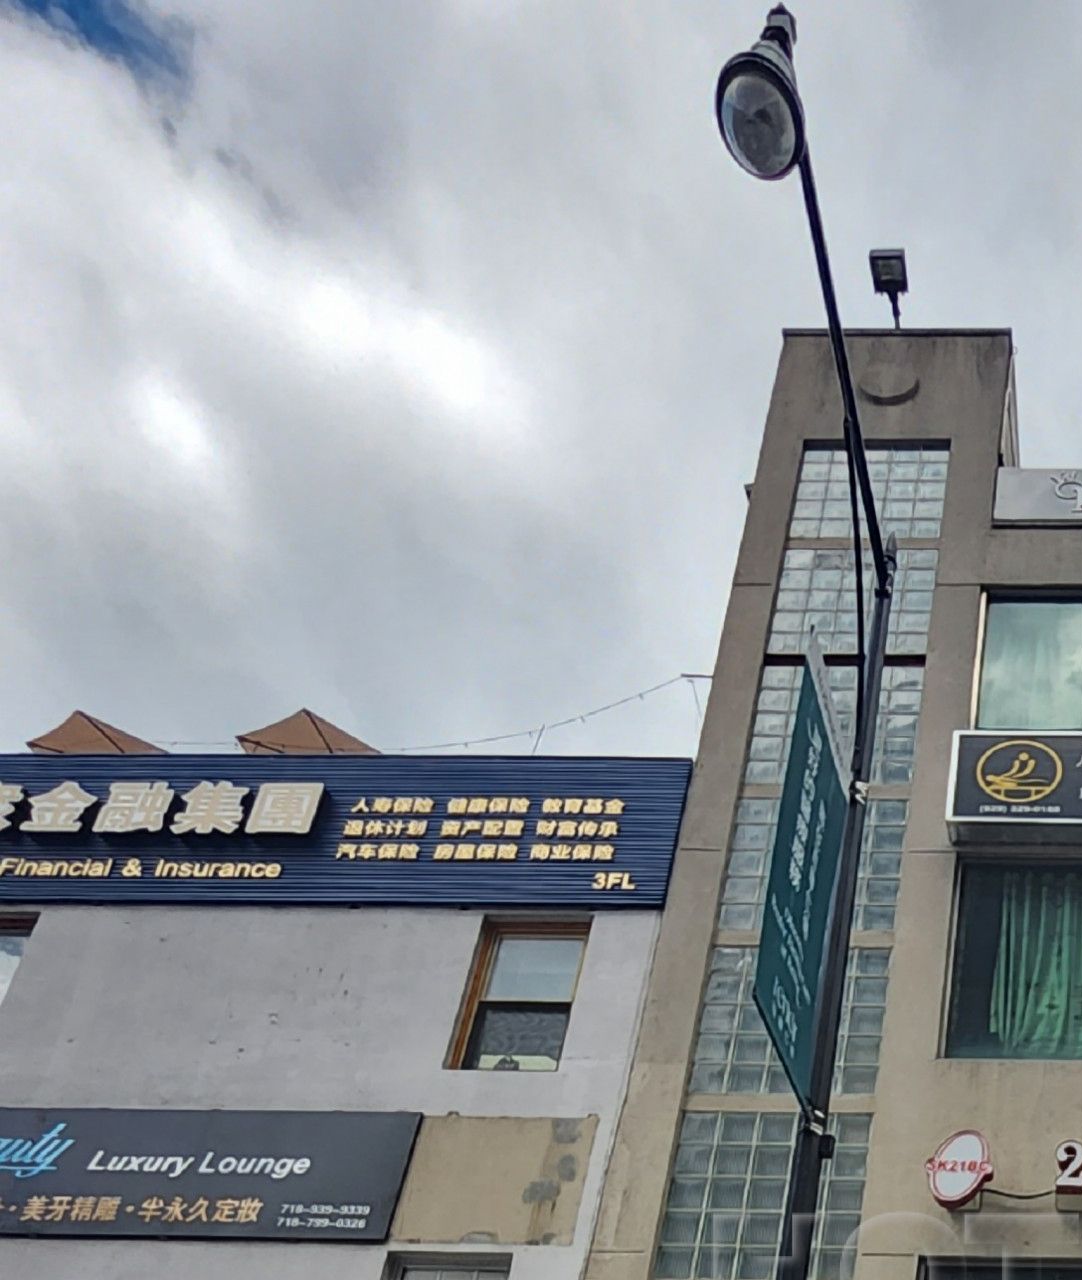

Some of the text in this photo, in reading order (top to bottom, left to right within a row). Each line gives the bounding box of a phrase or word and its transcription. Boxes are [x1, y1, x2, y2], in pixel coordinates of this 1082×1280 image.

[0, 858, 282, 878] Financial & Insurance
[592, 872, 635, 890] 3FL
[87, 1150, 311, 1178] Luxury Lounge
